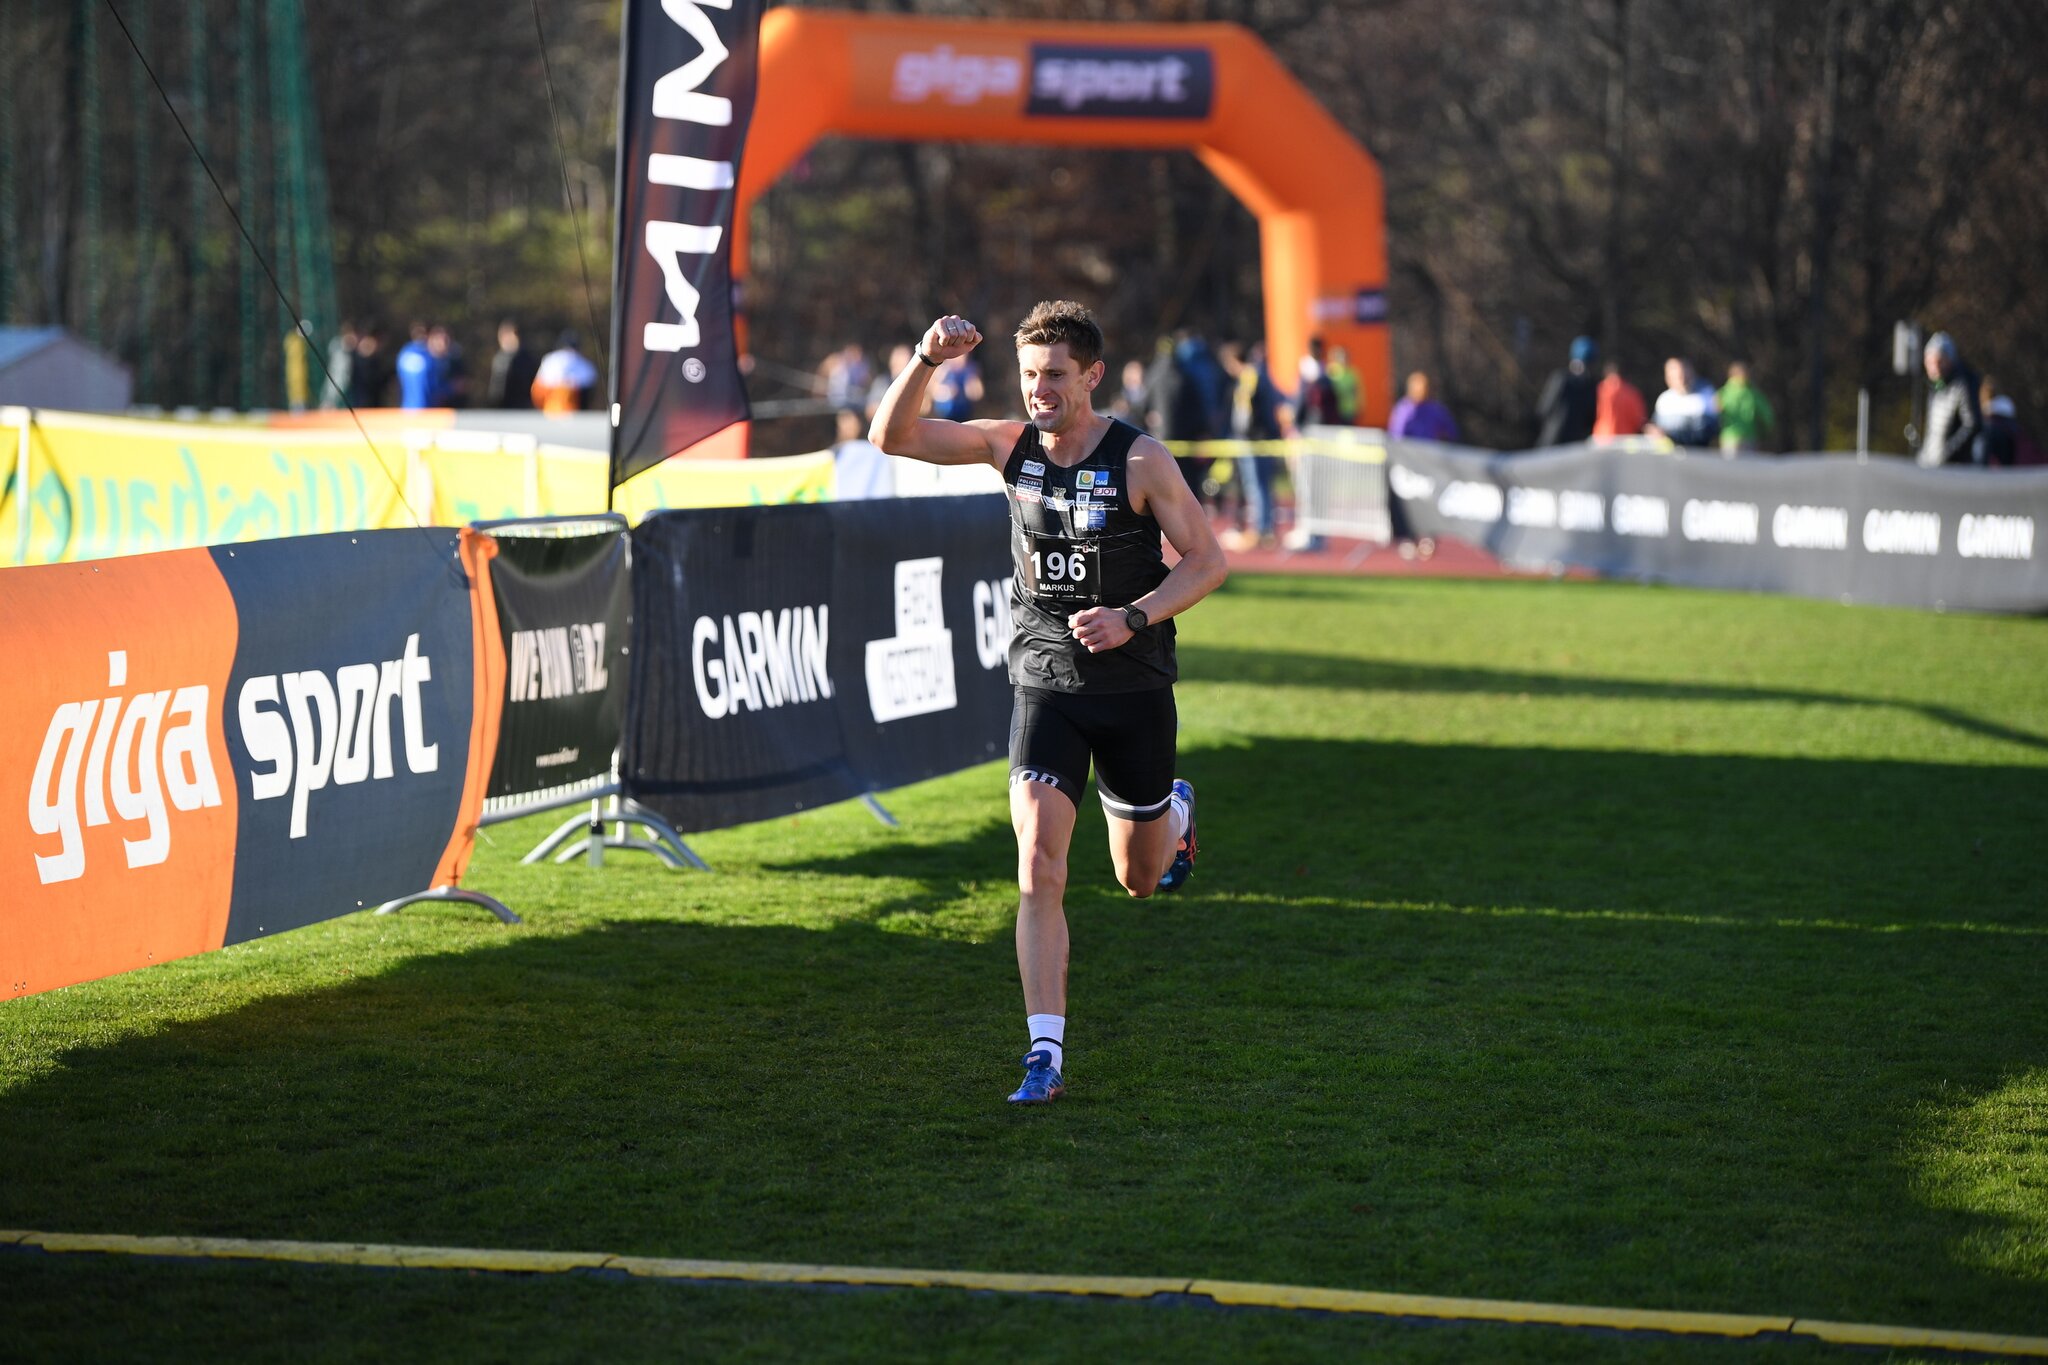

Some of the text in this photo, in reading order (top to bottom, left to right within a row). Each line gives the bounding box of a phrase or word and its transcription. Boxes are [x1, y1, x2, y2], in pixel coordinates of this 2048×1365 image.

[893, 45, 1189, 110] giga sport
[1863, 508, 1941, 556] GARMIN
[1957, 512, 2034, 560] GARMIN
[1030, 551, 1086, 581] 196
[1039, 583, 1075, 592] MARKUS
[692, 604, 829, 719] GARMIN
[28, 632, 439, 885] giga sport
